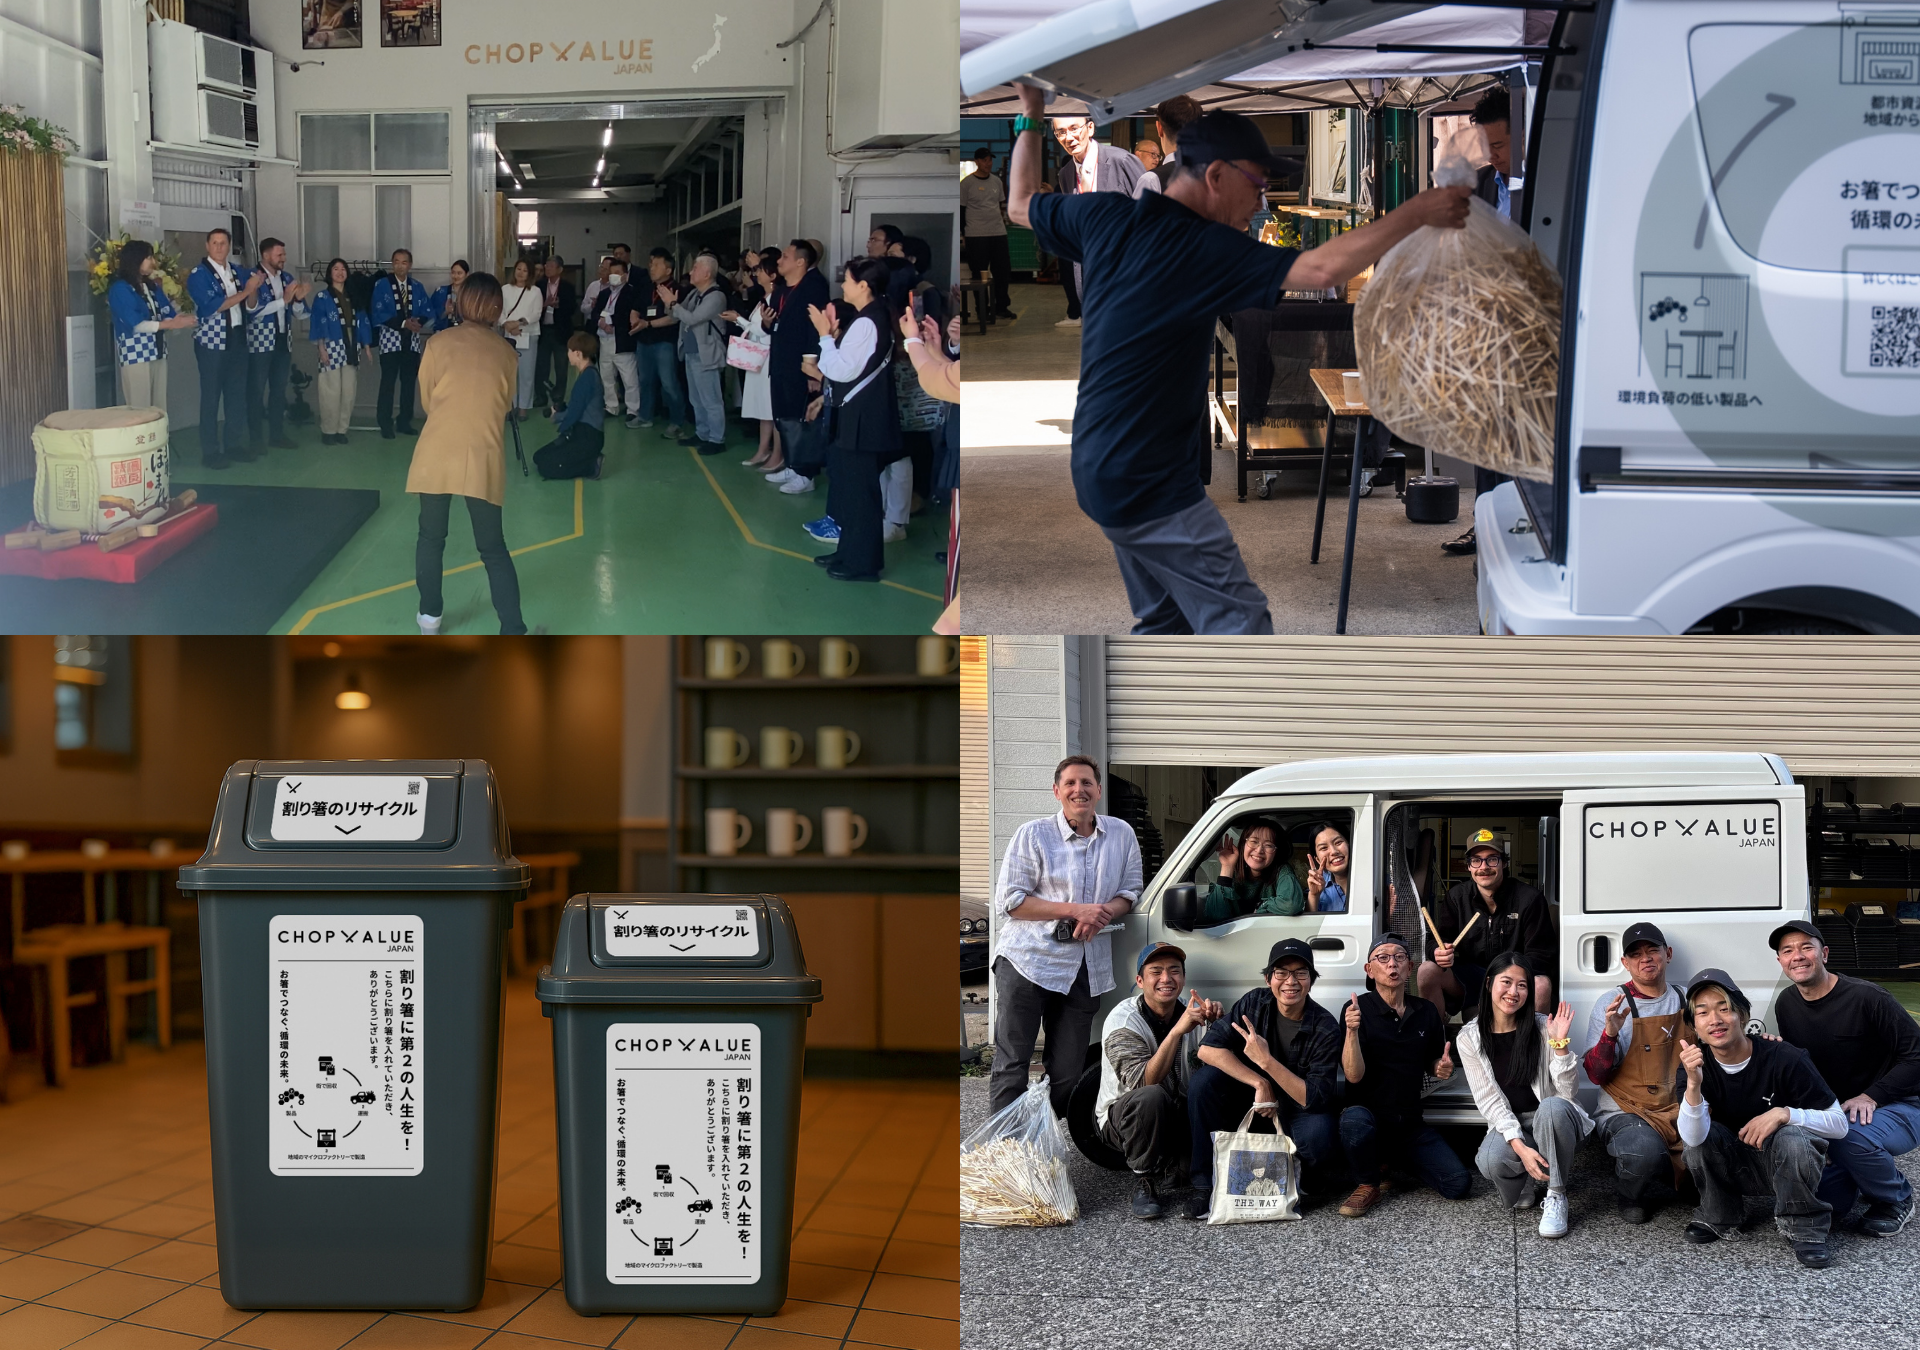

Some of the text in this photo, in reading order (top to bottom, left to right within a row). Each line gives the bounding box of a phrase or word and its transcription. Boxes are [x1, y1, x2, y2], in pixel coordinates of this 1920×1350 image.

[613, 62, 653, 75] JAPAN
[1840, 179, 1920, 201] お箸でつ
[1618, 389, 1763, 408] 環境負荷の低い製品へ
[281, 800, 418, 817] 割り箸のリサイクル
[1739, 838, 1775, 848] JAPAN
[613, 924, 750, 938] 割り箸のリサイクル
[386, 945, 414, 953] JAPAN
[279, 970, 290, 1083] お箸でつなぐ、循環の未来。
[369, 970, 379, 1069] ありがとうございます。
[383, 970, 394, 1116] こちらに割り箸を入れていただき、
[723, 1053, 751, 1061] JAPAN
[616, 1079, 627, 1192] お箸でつなぐ、循環の未来。
[706, 1079, 716, 1178] ありがとうございます。
[720, 1079, 731, 1225] こちらに割り箸を入れていただき、
[1234, 1198, 1278, 1208] THE WAY
